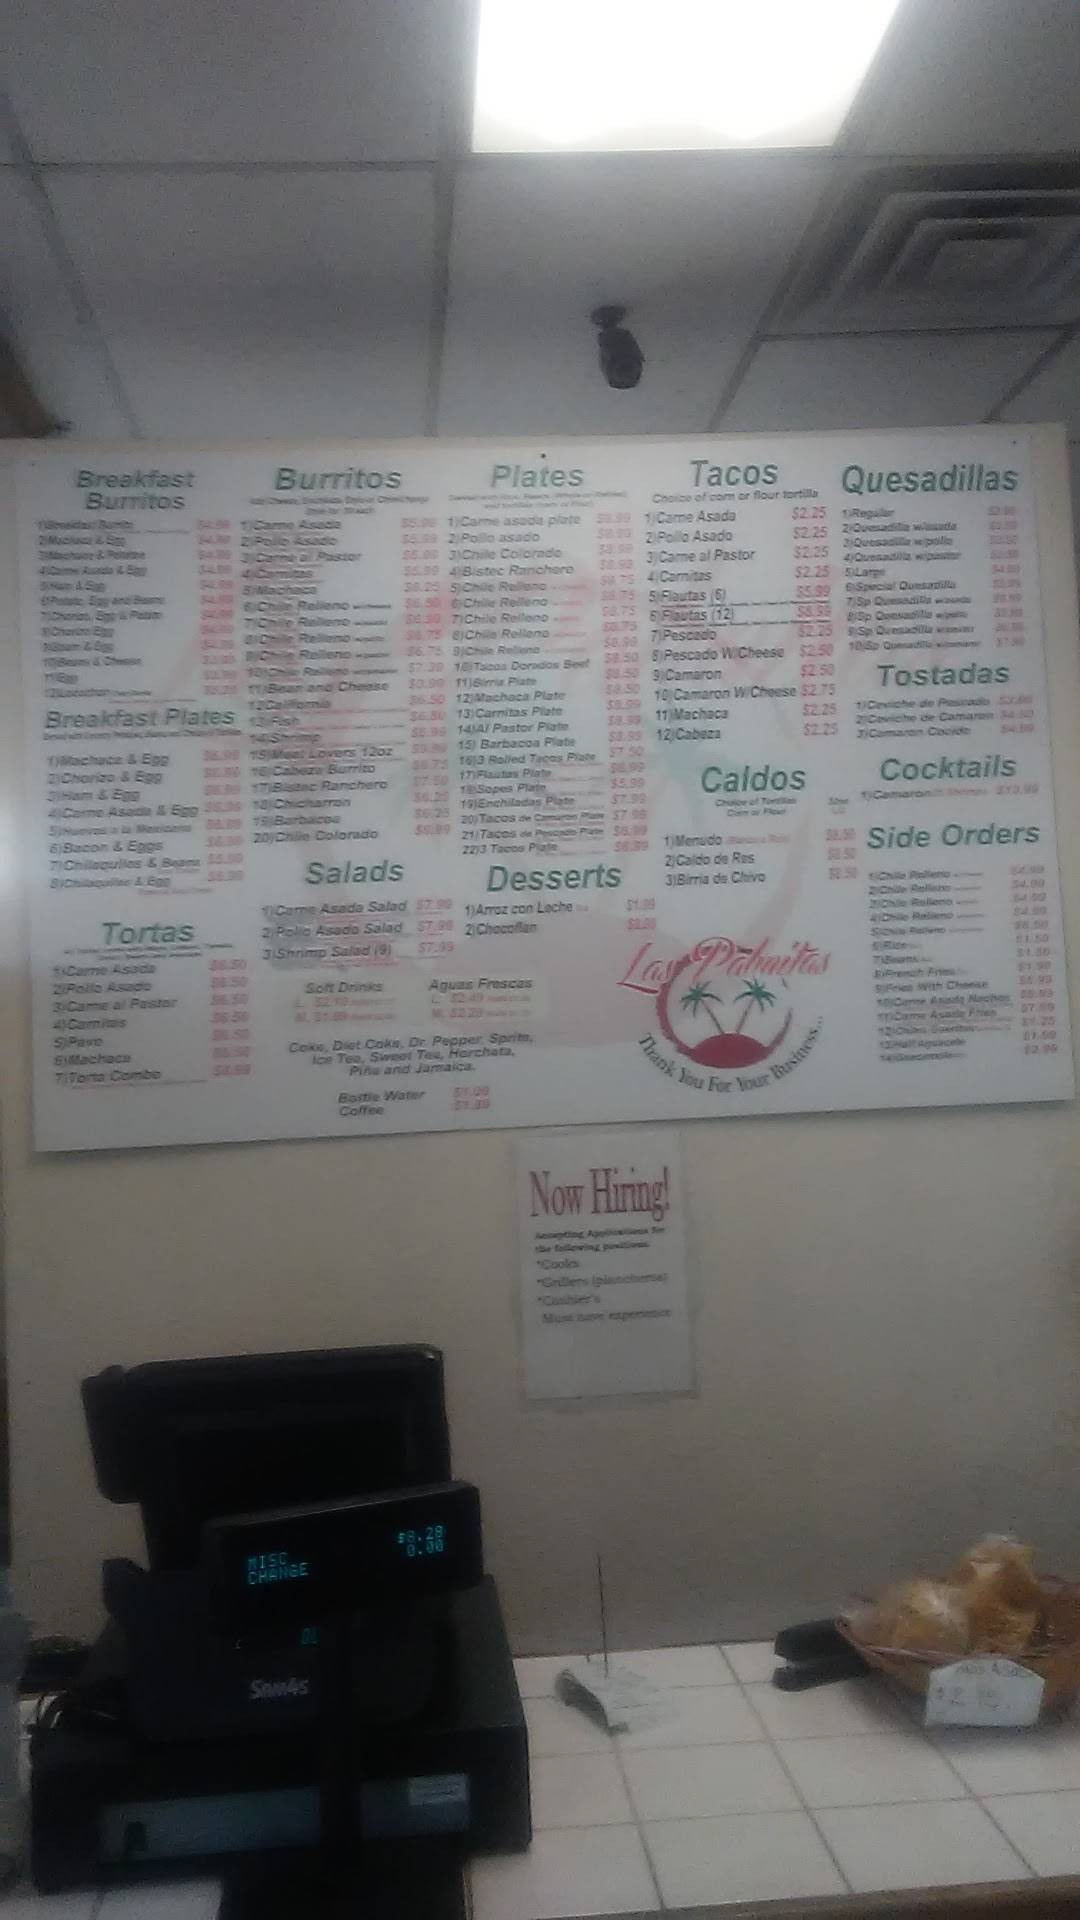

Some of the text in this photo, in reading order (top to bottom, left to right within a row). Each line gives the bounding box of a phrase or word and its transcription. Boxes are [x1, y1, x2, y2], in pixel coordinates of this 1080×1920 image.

[76, 469, 196, 488] Breakfast
[274, 467, 403, 490] Burritos
[490, 464, 585, 488] Plates
[690, 460, 779, 487] Tacos
[842, 464, 1019, 495] Quesadillas
[85, 492, 186, 510] Burritos
[652, 493, 692, 503] Choice
[695, 493, 707, 501] of
[738, 491, 750, 501] or
[753, 490, 780, 500] flour
[782, 489, 819, 499] tortilla
[503, 516, 544, 526] asada
[547, 515, 581, 527] plate
[697, 510, 736, 522] Asada
[792, 506, 827, 520] $2.25
[499, 532, 540, 542] asado
[692, 530, 733, 542] Asado
[793, 527, 827, 539] $2.25
[500, 548, 563, 559] Colorado
[699, 549, 710, 562] al
[713, 549, 757, 560] Pastor
[793, 546, 829, 559] $2.25
[509, 564, 575, 576] Ranchero
[795, 566, 830, 578] $2.25
[712, 608, 734, 621] (12)
[877, 663, 1010, 687] Tostadas
[534, 692, 566, 700] Plate
[801, 684, 836, 697] $2.75
[45, 708, 235, 728] Breakfast Plates
[532, 707, 564, 716] Plate
[492, 723, 534, 733] Pastor
[537, 722, 569, 731] Plate
[128, 754, 137, 764] &
[142, 753, 169, 767] Egg
[880, 755, 1017, 781] Cocktails
[701, 765, 806, 793] Caldos
[867, 824, 1040, 849] Side Orders
[714, 853, 729, 865] de
[732, 852, 755, 864] Res
[305, 860, 404, 885] Salads
[486, 863, 622, 892] Desserts
[712, 873, 729, 885] de
[731, 872, 766, 884] Chivo
[320, 904, 363, 913] Asada
[368, 901, 408, 912] Salad
[512, 904, 535, 914] con
[538, 901, 573, 914] Leche
[102, 922, 195, 945] Tortas
[316, 926, 360, 936] Asado
[363, 923, 403, 934] Salad
[331, 945, 370, 957] Salad
[617, 942, 672, 994] Las
[305, 981, 384, 994] Soft Drinks
[428, 978, 533, 992] Aguas Frescas
[332, 1040, 360, 1051] Diet
[312, 1055, 332, 1065] Ice
[370, 1051, 412, 1063] Sweet
[638, 1032, 678, 1077] Thank
[678, 1067, 704, 1089] You
[708, 1076, 732, 1092] For
[736, 1074, 770, 1092] Your
[384, 1065, 410, 1075] and
[384, 1090, 426, 1101] Water
[338, 1105, 384, 1117] Coffee
[529, 1165, 671, 1222] Now Hiring!
[248, 1552, 288, 1571] MISC
[248, 1562, 310, 1585] CHANGE
